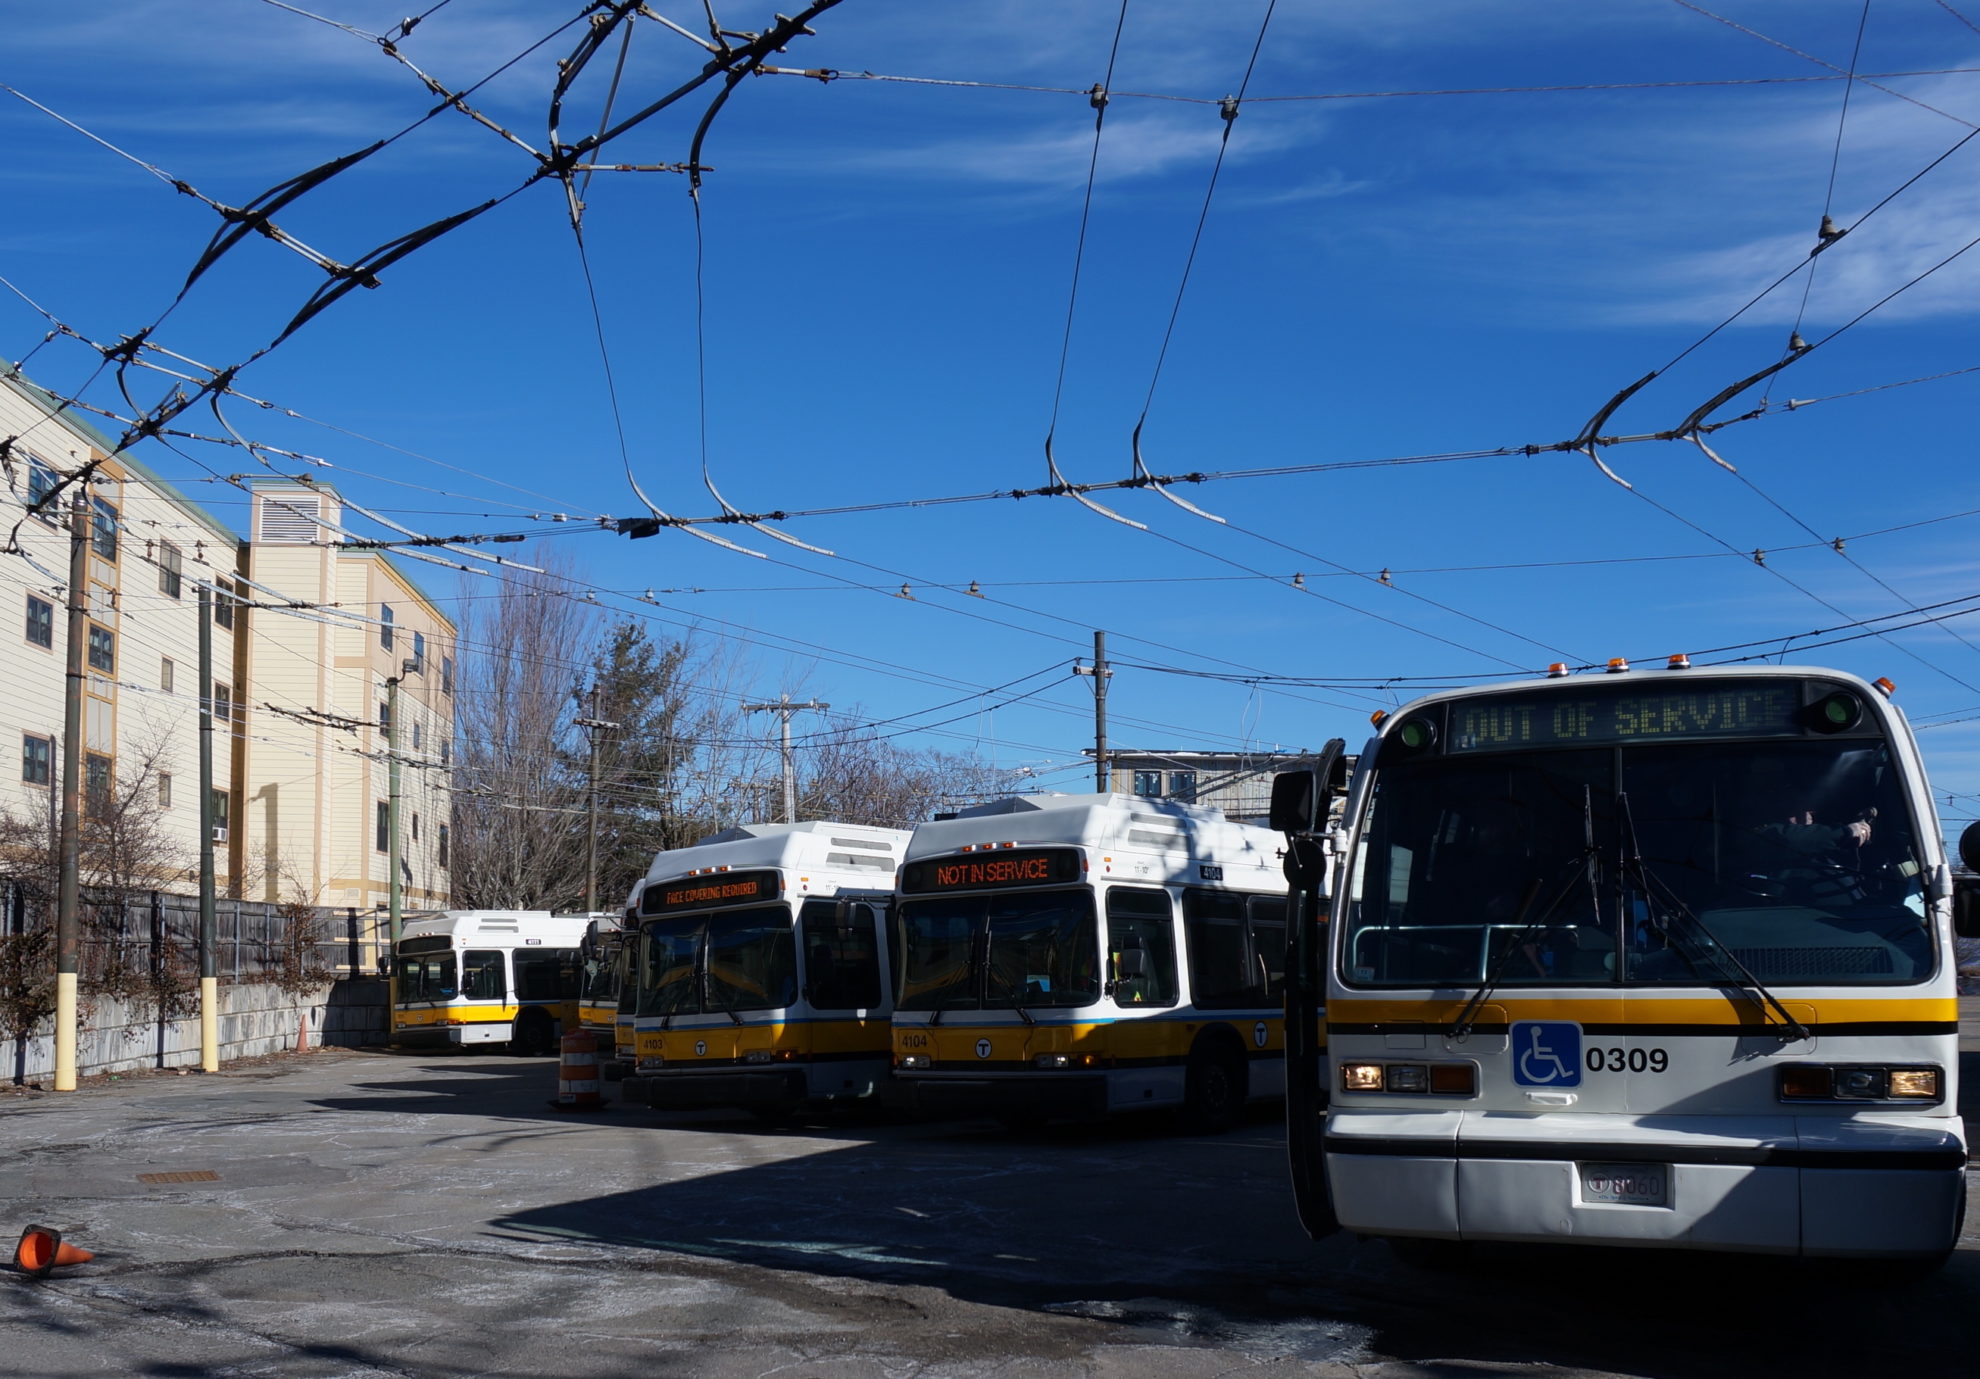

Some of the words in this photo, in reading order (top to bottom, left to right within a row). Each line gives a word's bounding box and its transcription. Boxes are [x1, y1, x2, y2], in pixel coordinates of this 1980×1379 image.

[1465, 704, 1537, 743] OUT
[1554, 701, 1597, 739] OF
[1614, 689, 1785, 736] SERVICE
[937, 865, 969, 886] NOT
[970, 863, 984, 883] IN
[986, 858, 1049, 882] SERVICE
[666, 891, 685, 905] FACE
[685, 886, 721, 902] COVERING
[722, 881, 758, 899] REQUIRED
[643, 1039, 663, 1050] 4103
[902, 1034, 928, 1049] 4104
[1586, 1047, 1669, 1074] 0309
